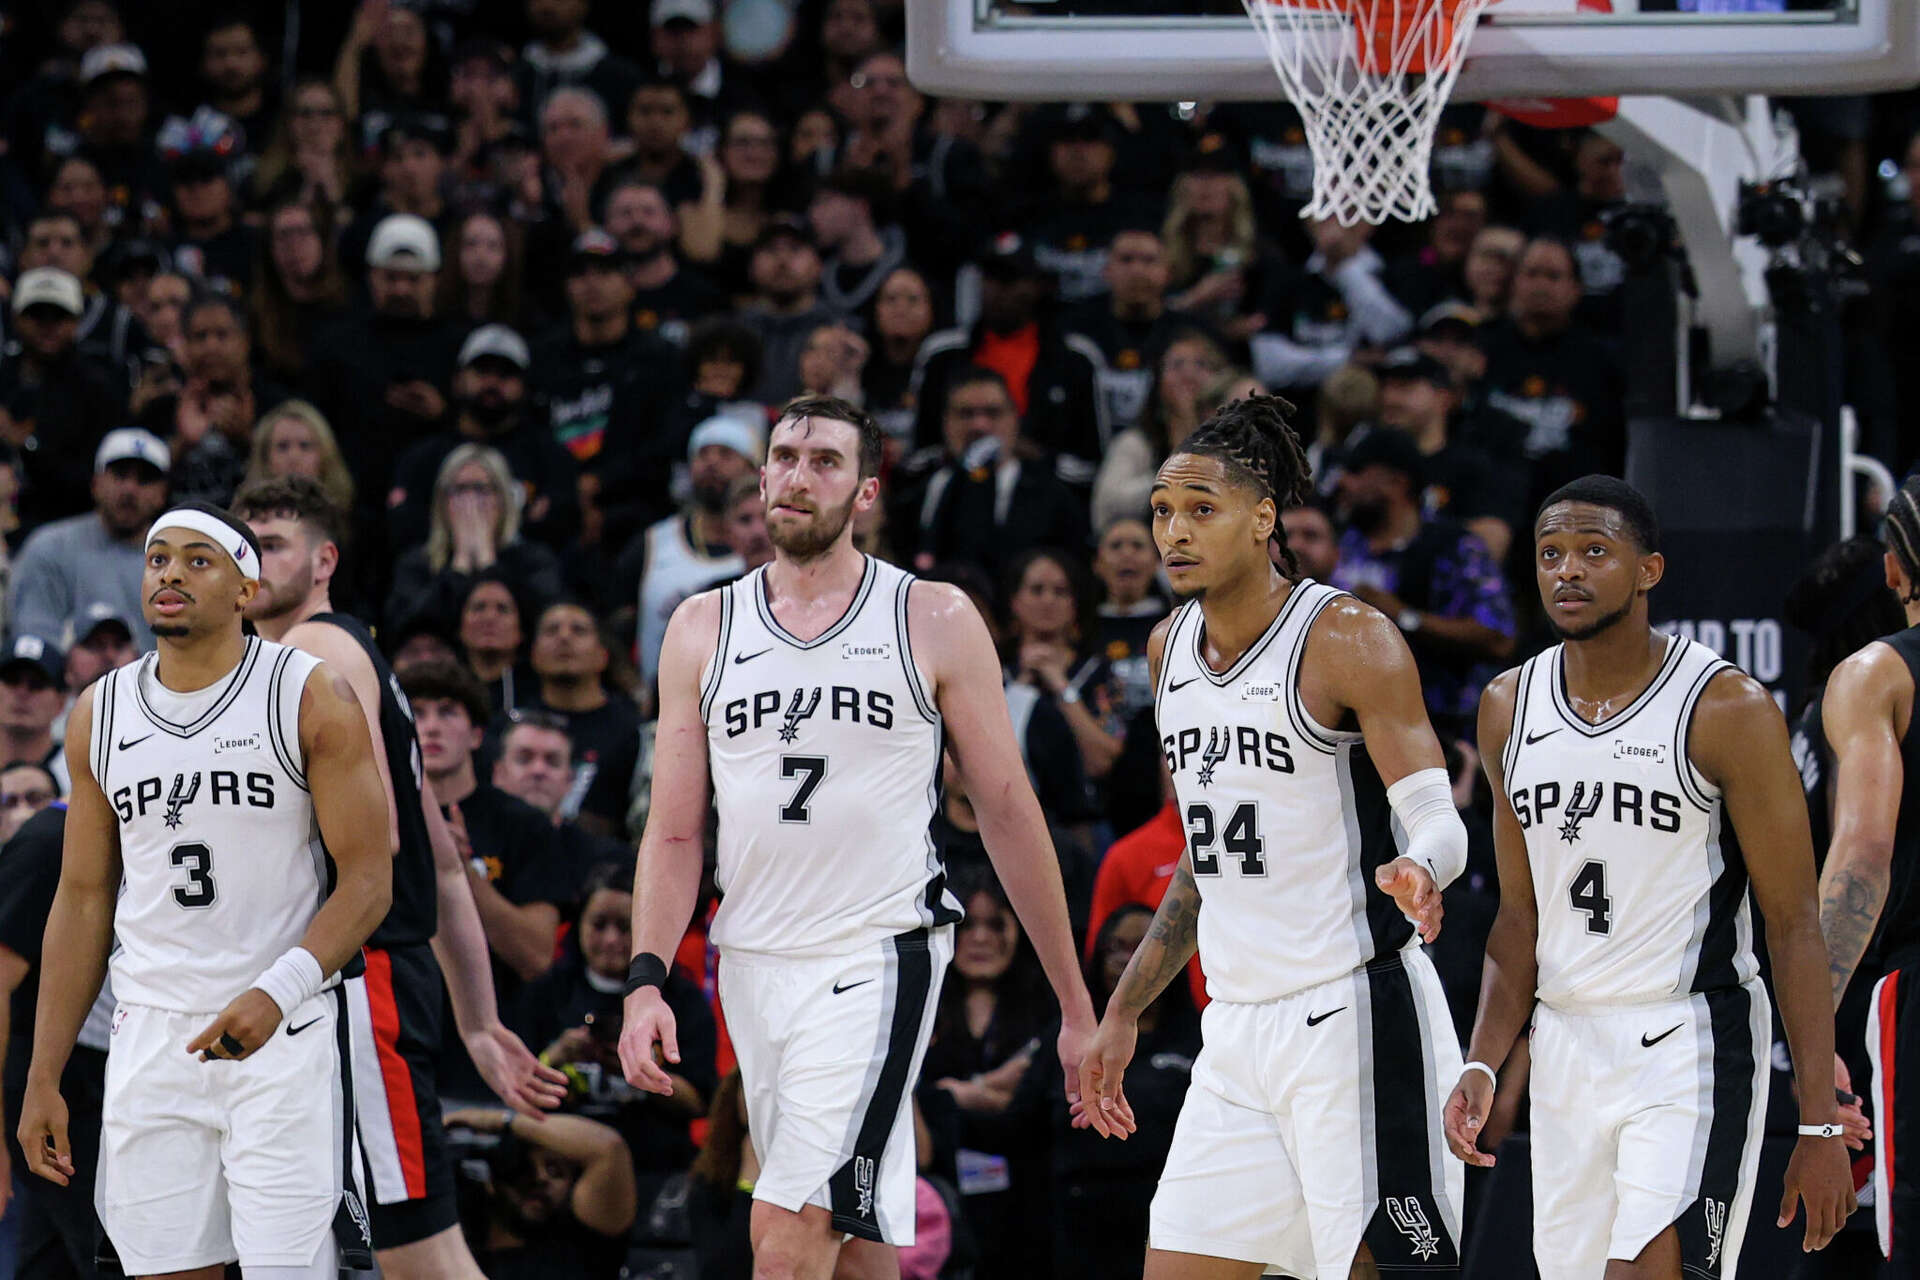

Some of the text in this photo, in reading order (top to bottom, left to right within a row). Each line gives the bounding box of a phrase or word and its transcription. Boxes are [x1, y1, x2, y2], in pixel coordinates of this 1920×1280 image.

[848, 647, 884, 655] LEDGER
[725, 686, 894, 745] SPURS
[1246, 687, 1274, 696] LEDGER
[219, 738, 255, 750] LEDGER
[1163, 726, 1295, 790] SPURS
[1620, 745, 1659, 758] LEDGER
[113, 770, 275, 831] SPURS
[779, 753, 829, 825] 7
[1512, 781, 1681, 846] SPURS
[1187, 800, 1269, 878] 24
[168, 840, 220, 911] 3
[1567, 858, 1614, 937] 4
